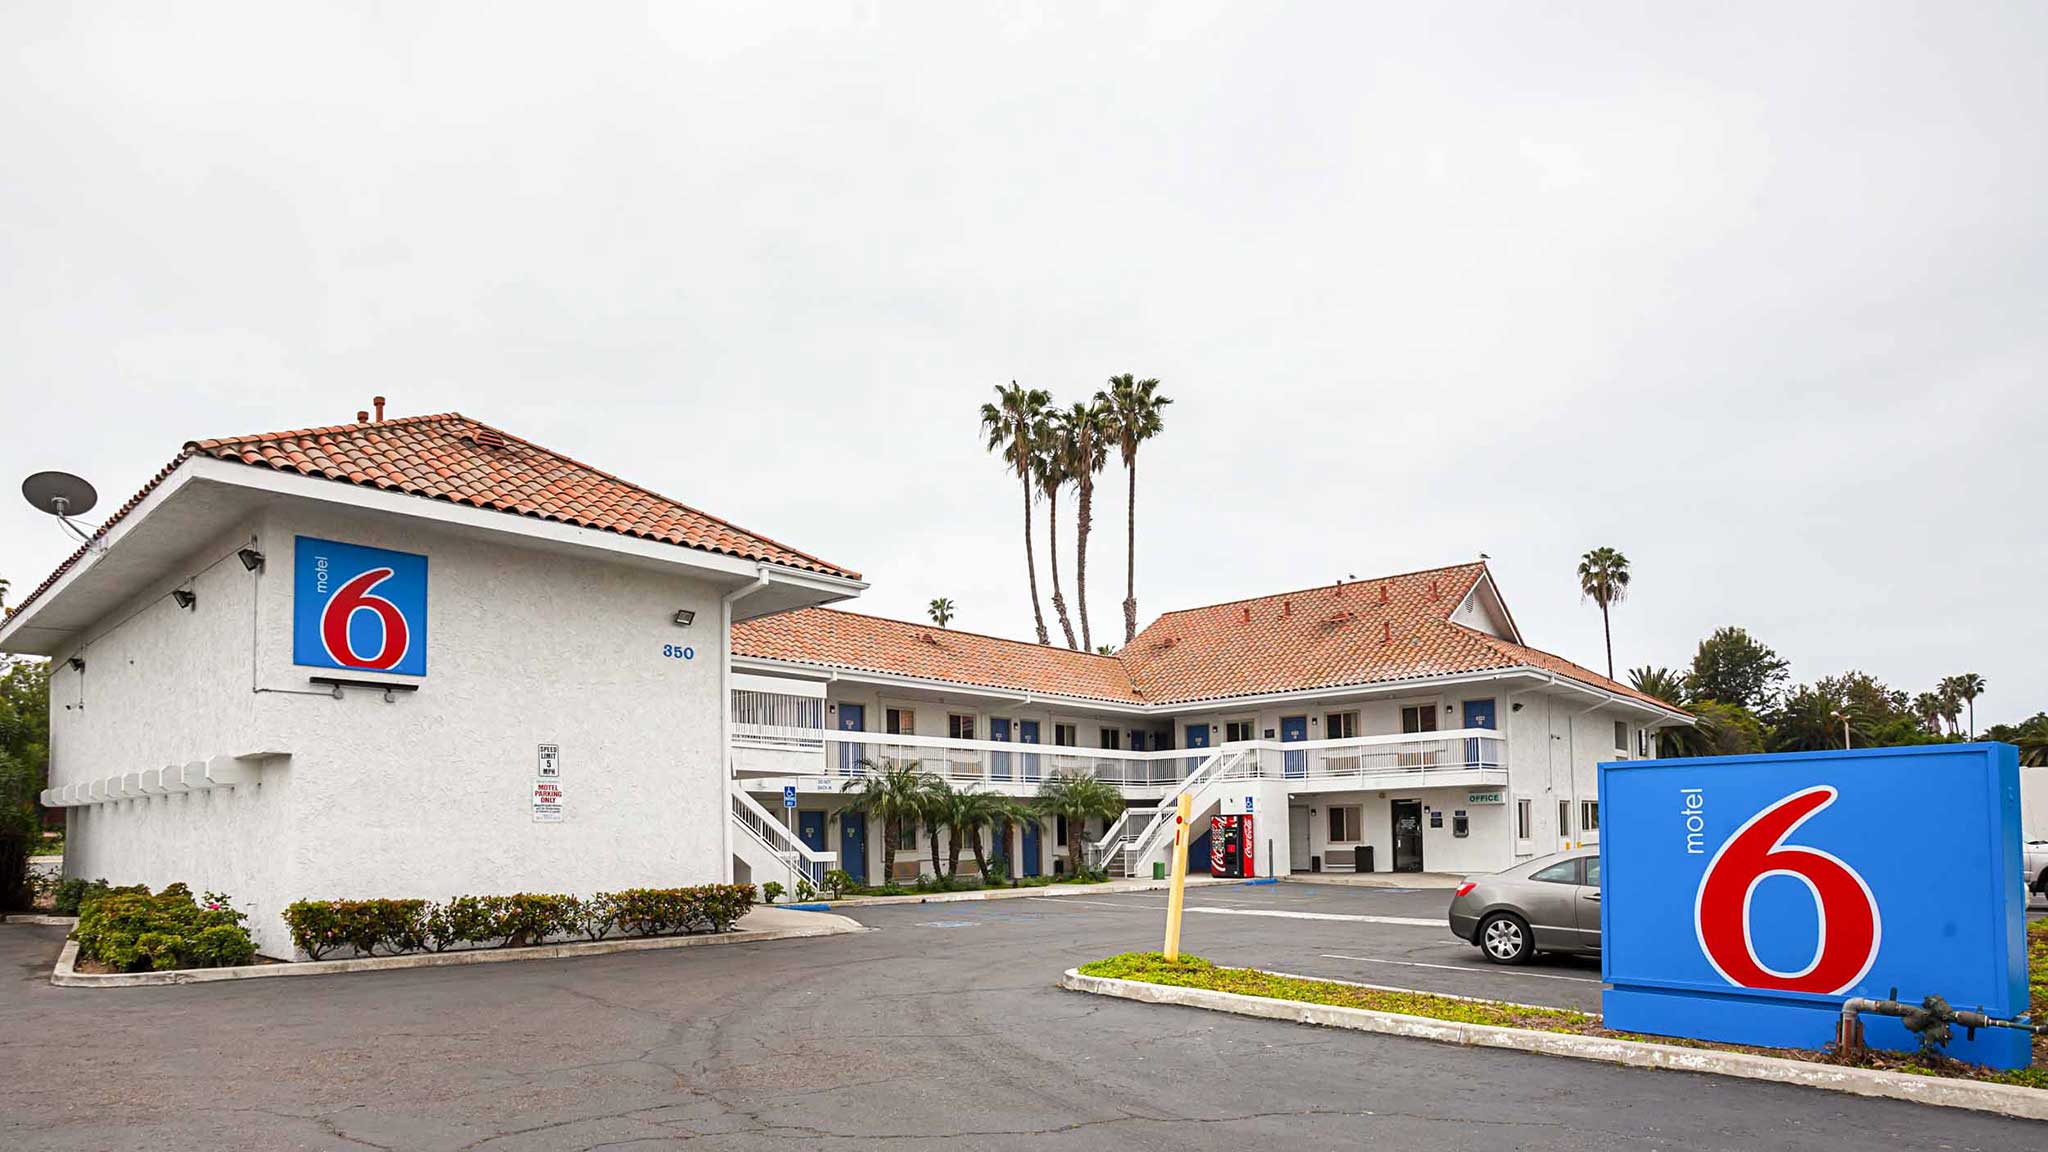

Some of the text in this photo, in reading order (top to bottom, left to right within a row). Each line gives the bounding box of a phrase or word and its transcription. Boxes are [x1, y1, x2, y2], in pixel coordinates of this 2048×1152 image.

[314, 556, 410, 670] motel 6
[663, 644, 695, 660] 350
[546, 760, 552, 768] 5
[1469, 794, 1500, 802] OFFICE
[1680, 784, 1882, 996] motel 6
